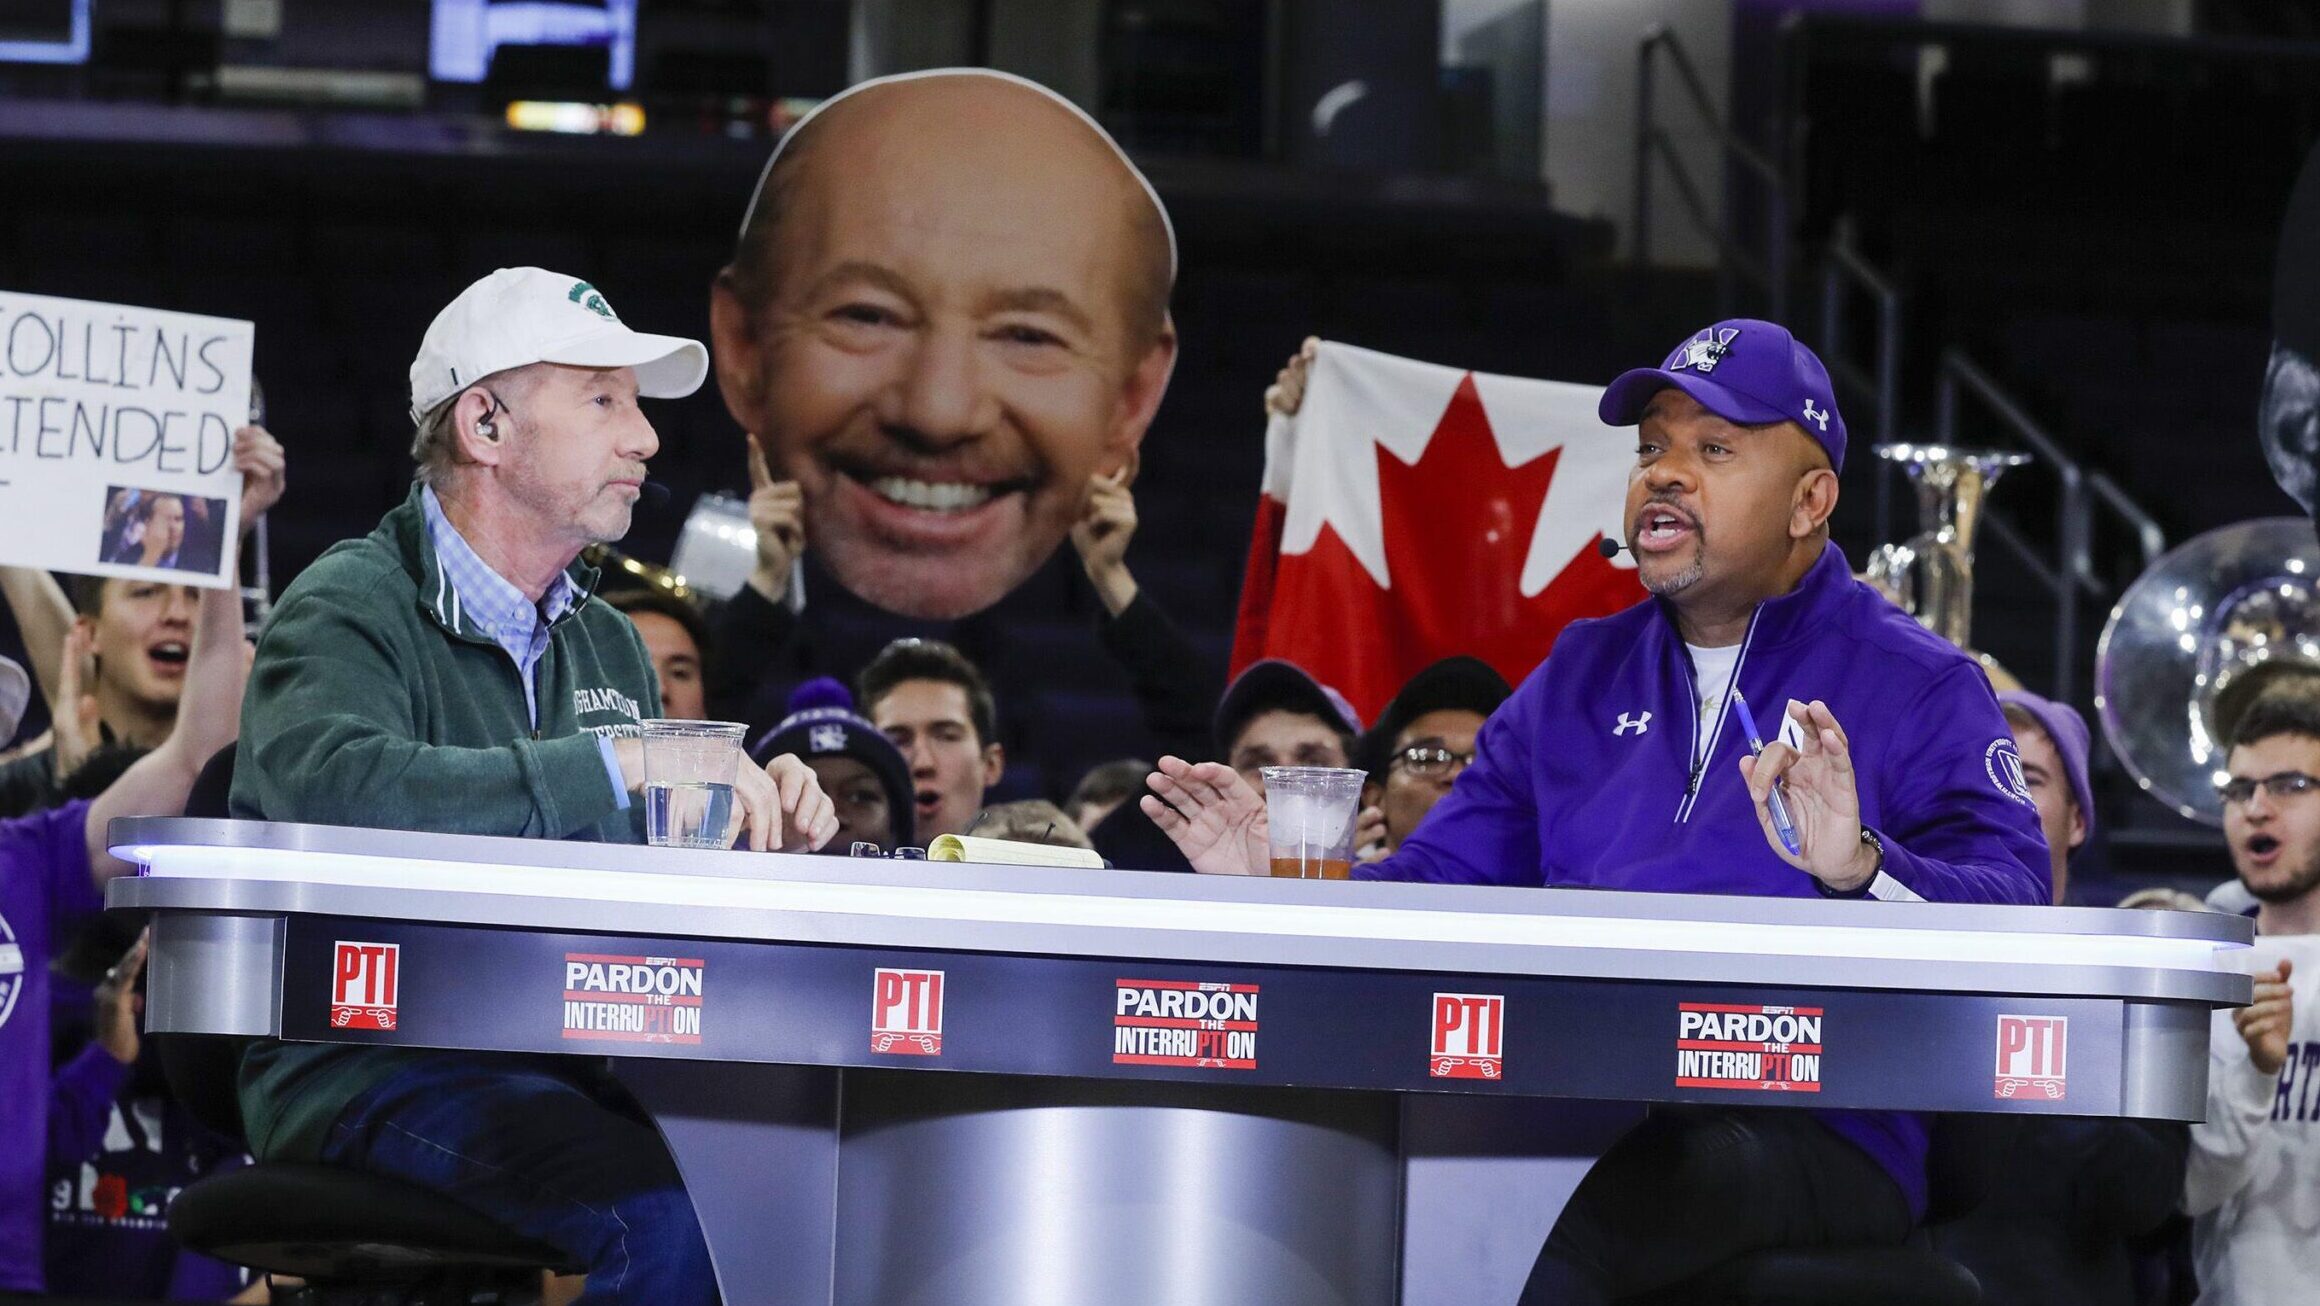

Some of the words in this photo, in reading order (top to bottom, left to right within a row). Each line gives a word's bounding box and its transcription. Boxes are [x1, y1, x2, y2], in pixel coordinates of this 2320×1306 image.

[0, 307, 228, 394] OLLINS
[0, 396, 231, 475] TENDED
[573, 688, 641, 720] GHAMTON
[335, 945, 396, 1005] PTI
[645, 956, 677, 966] ESPN
[565, 962, 703, 996] PARDON
[1198, 982, 1231, 992] ESPN
[646, 994, 672, 1005] THE
[875, 971, 941, 1031] PTI
[1116, 988, 1258, 1021] PARDON
[1762, 1005, 1794, 1015] ESPN
[563, 1001, 701, 1035] INTERRUPTION
[1199, 1019, 1226, 1030] THE
[1434, 996, 1501, 1055] PTI
[1679, 1011, 1822, 1044] PARDON
[1114, 1026, 1256, 1060] INTERRUPTION
[1763, 1042, 1790, 1053] THE
[1999, 1018, 2065, 1076] PTI
[1677, 1050, 1820, 1082] INTERRUPTION
[2271, 1042, 2320, 1122] RT
